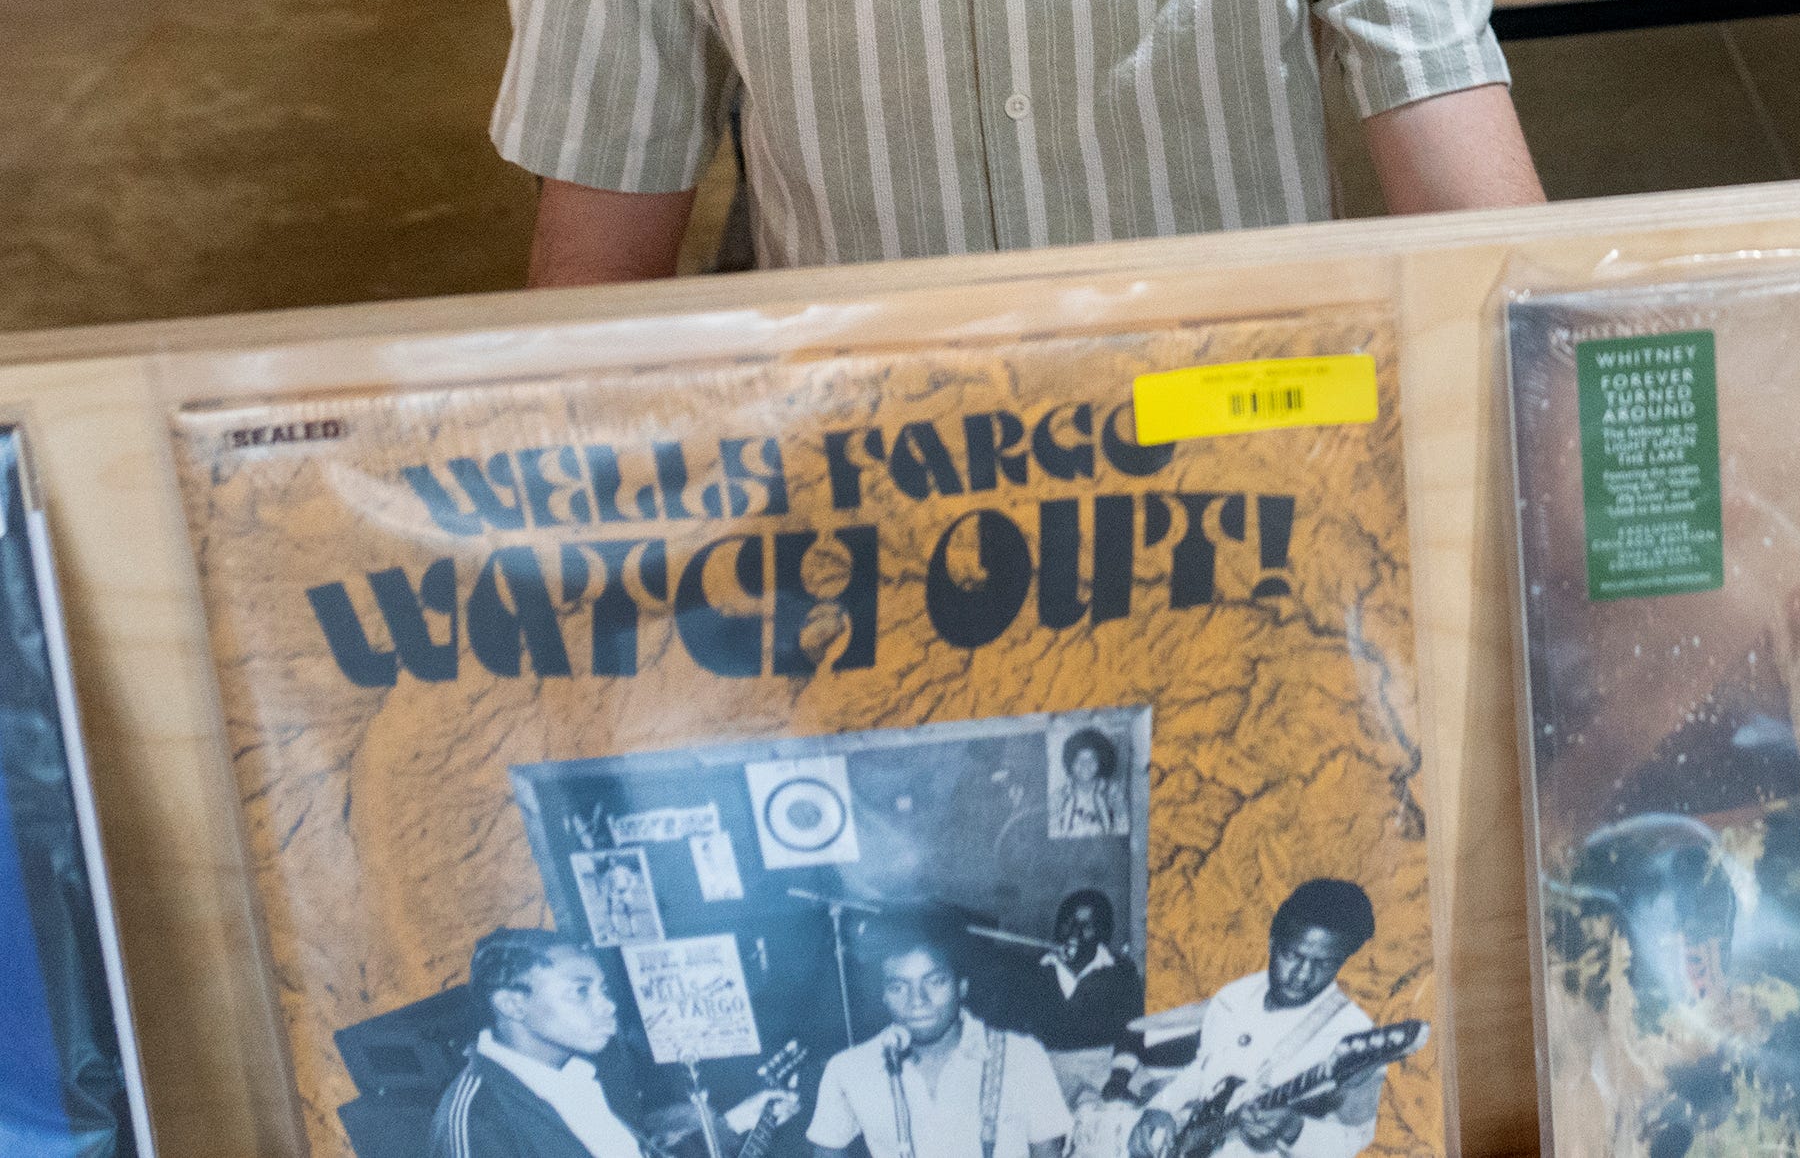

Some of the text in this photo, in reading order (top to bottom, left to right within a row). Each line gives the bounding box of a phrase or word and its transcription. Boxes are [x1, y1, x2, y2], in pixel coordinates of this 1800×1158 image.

[1595, 344, 1697, 369] WHITNEY
[1600, 367, 1695, 391] FOREVER
[1605, 384, 1693, 407] TURNED
[1602, 400, 1697, 426] AROUND
[232, 419, 341, 448] SEALED
[402, 435, 789, 536] WELLS
[925, 492, 1298, 648] OUT!
